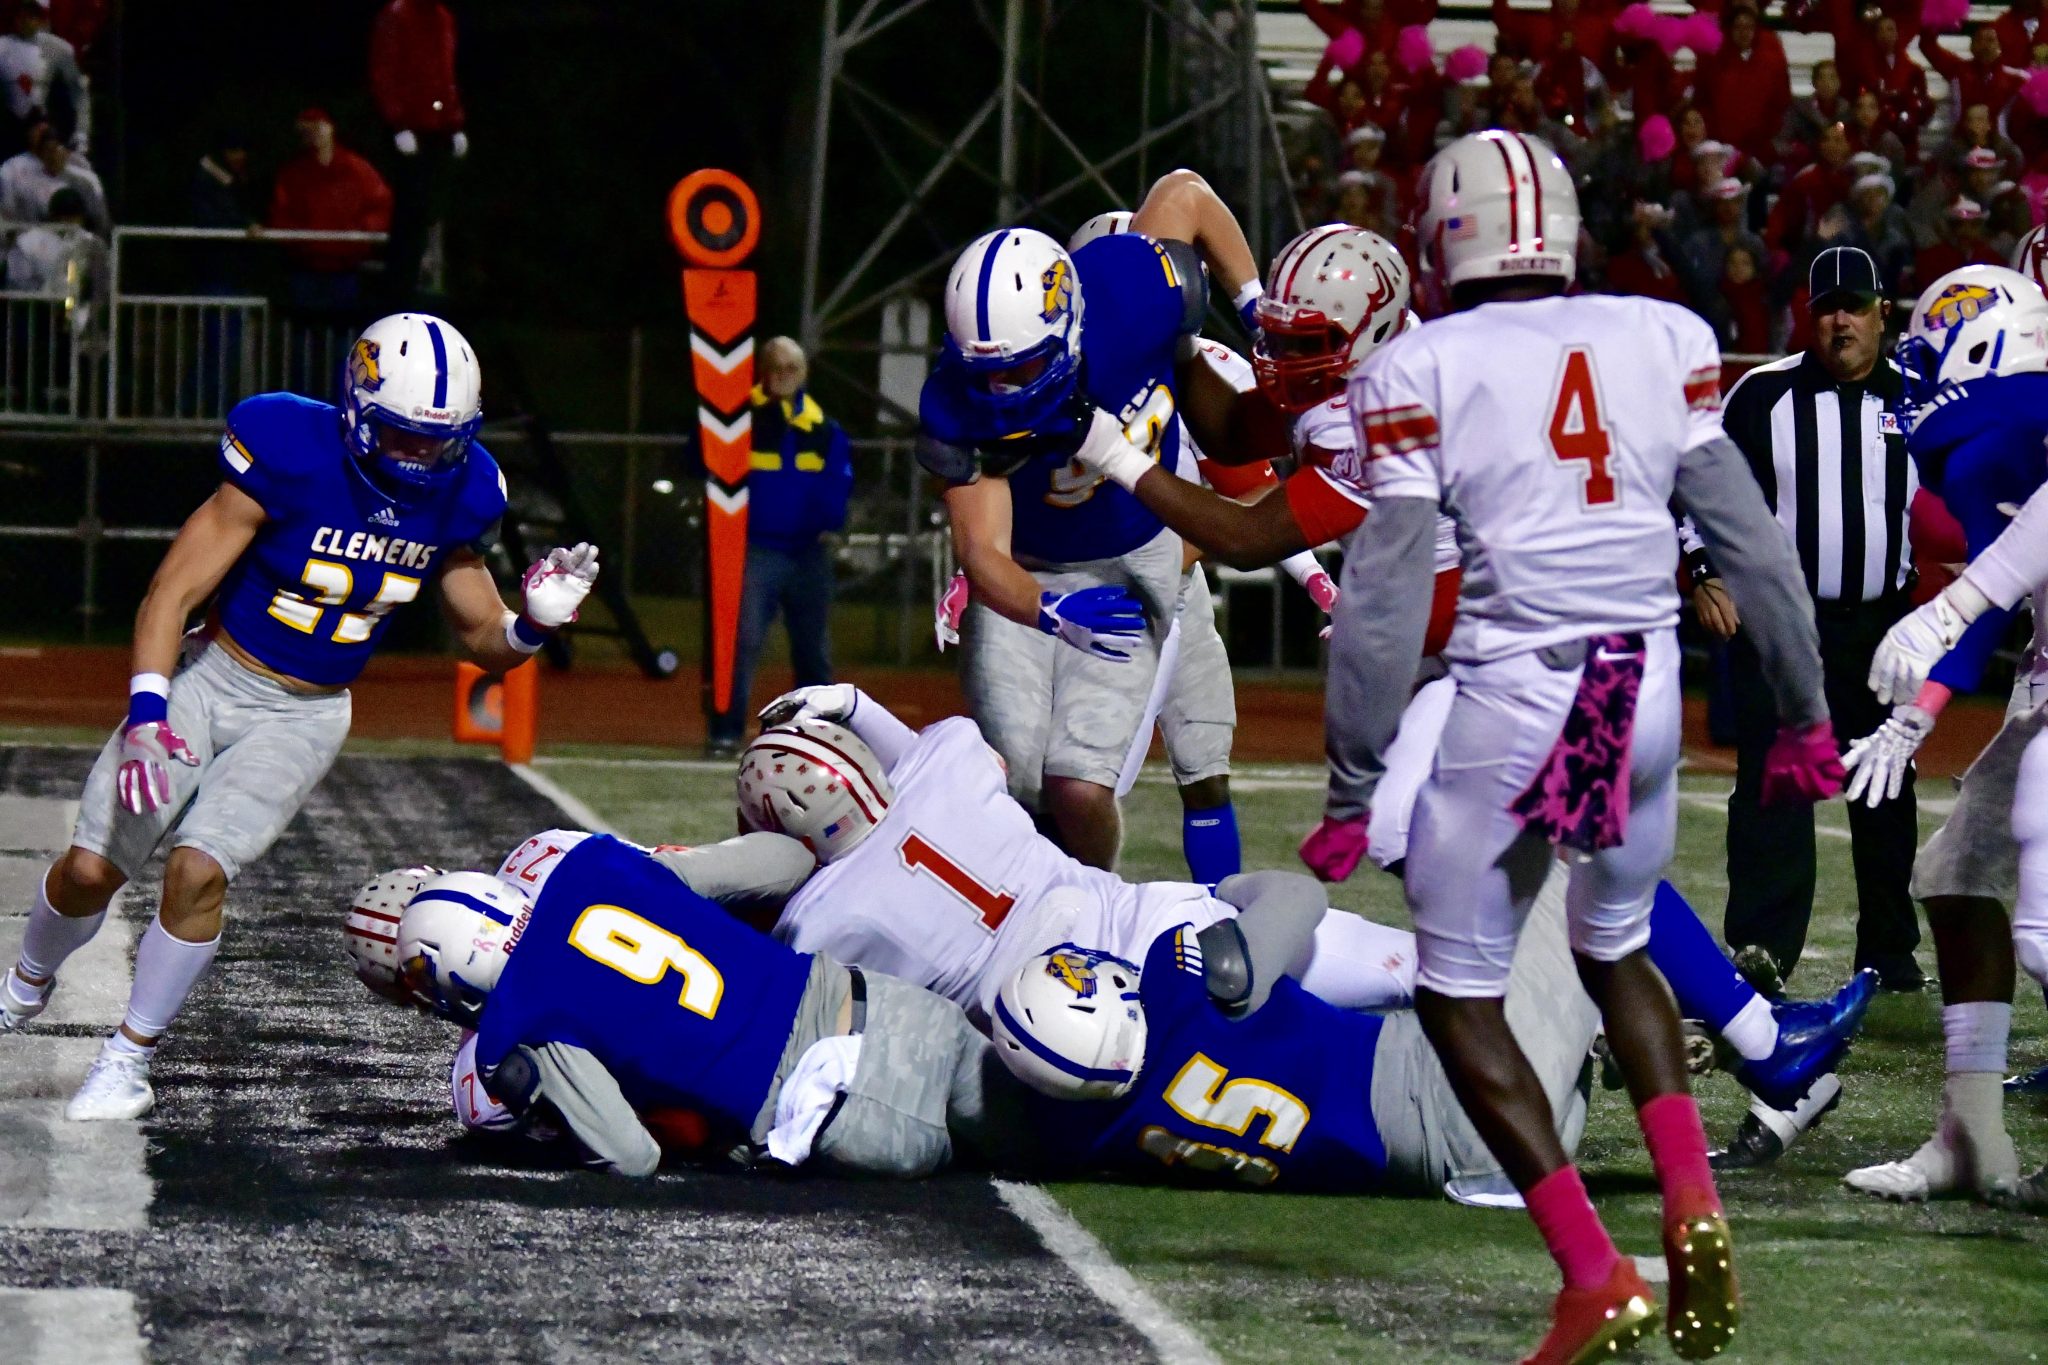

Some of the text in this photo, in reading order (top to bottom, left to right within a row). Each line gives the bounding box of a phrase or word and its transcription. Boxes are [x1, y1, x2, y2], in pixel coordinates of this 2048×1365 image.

[1541, 343, 1623, 512] 4
[311, 526, 438, 570] CLEMENS
[267, 558, 422, 644] 25
[502, 903, 536, 956] Riddell
[895, 827, 1018, 937] 1
[567, 903, 724, 1020] 9
